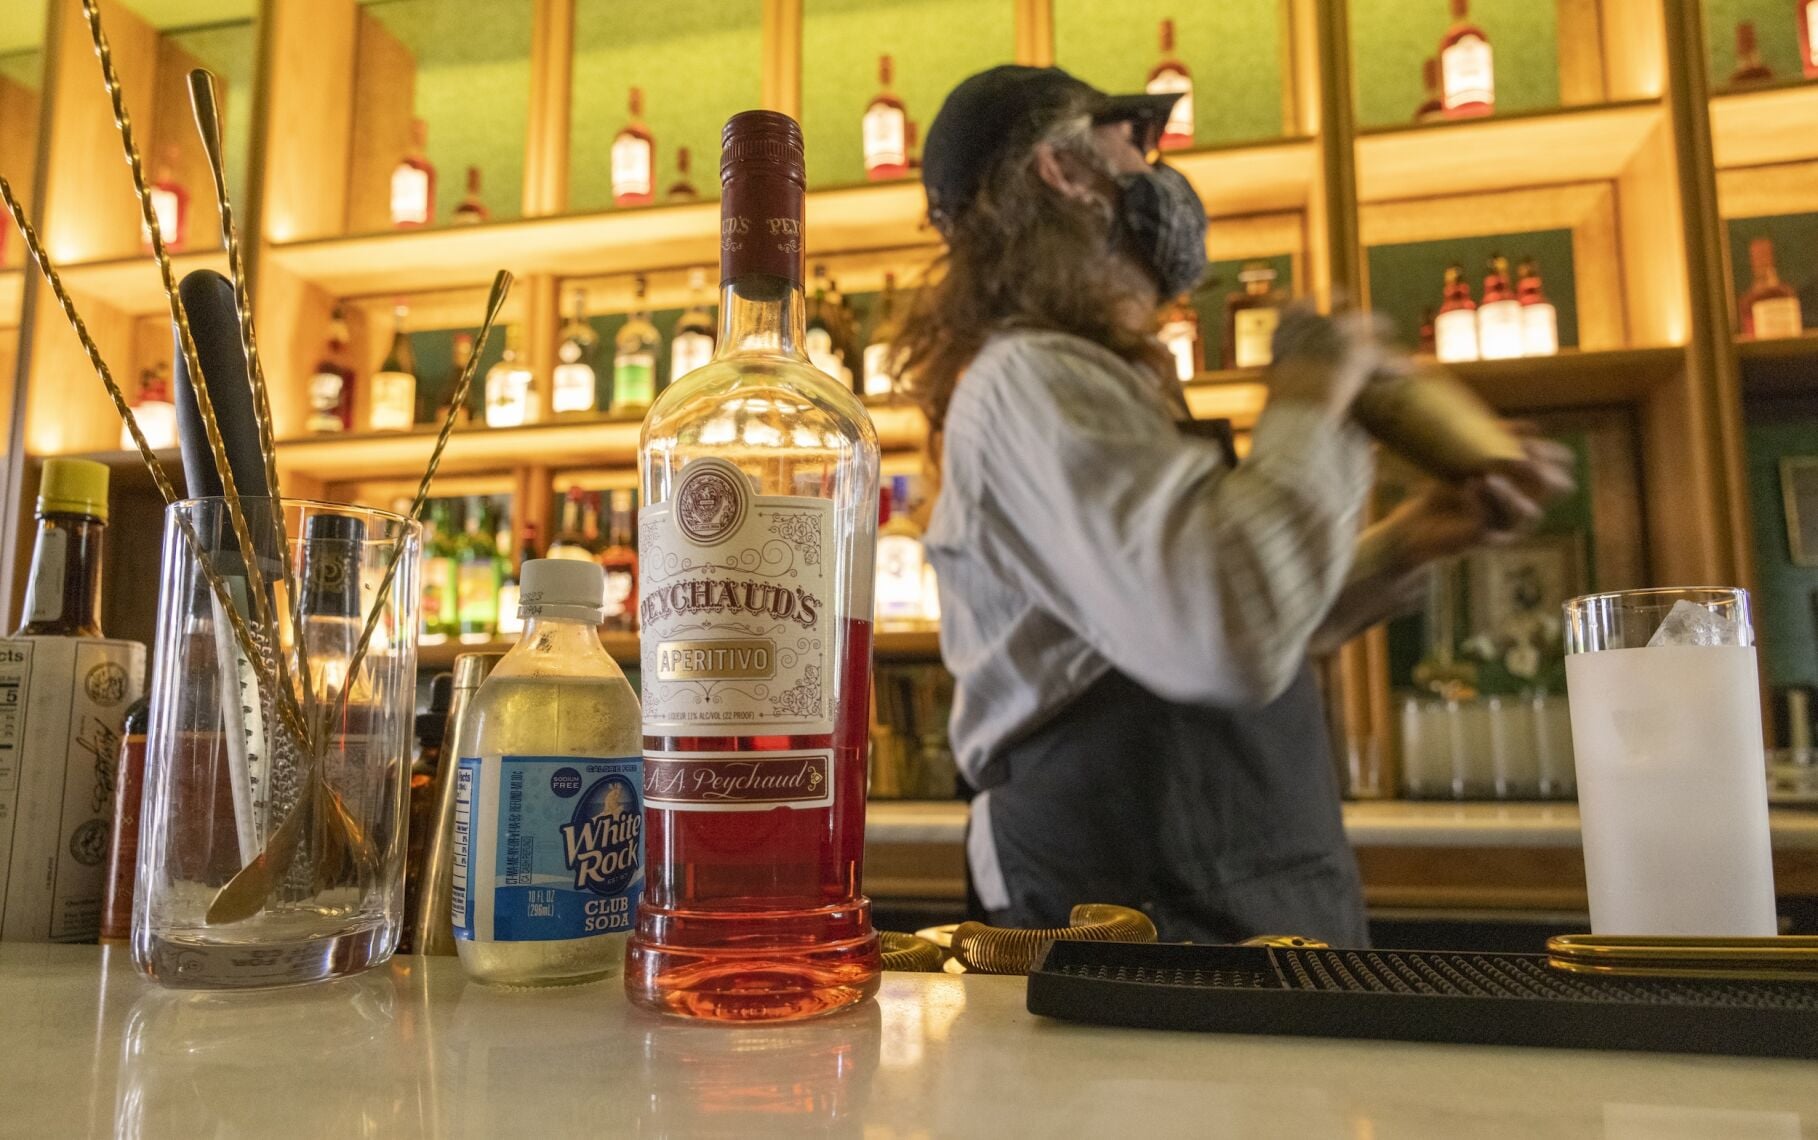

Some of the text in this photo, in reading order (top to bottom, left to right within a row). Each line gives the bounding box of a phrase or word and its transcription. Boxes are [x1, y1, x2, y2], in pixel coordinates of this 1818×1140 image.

[640, 576, 823, 629] PEYCHAUD'S
[660, 646, 769, 673] APERITIVO
[733, 711, 755, 721] PROOF)
[552, 781, 580, 789] FREE
[693, 760, 809, 800] Peychaud
[563, 811, 641, 868] White
[577, 838, 639, 887] Rock
[528, 889, 556, 903] 10 FL OZ
[584, 896, 629, 916] CLUB
[527, 902, 554, 918] (296mL)
[584, 912, 630, 932] SODA
